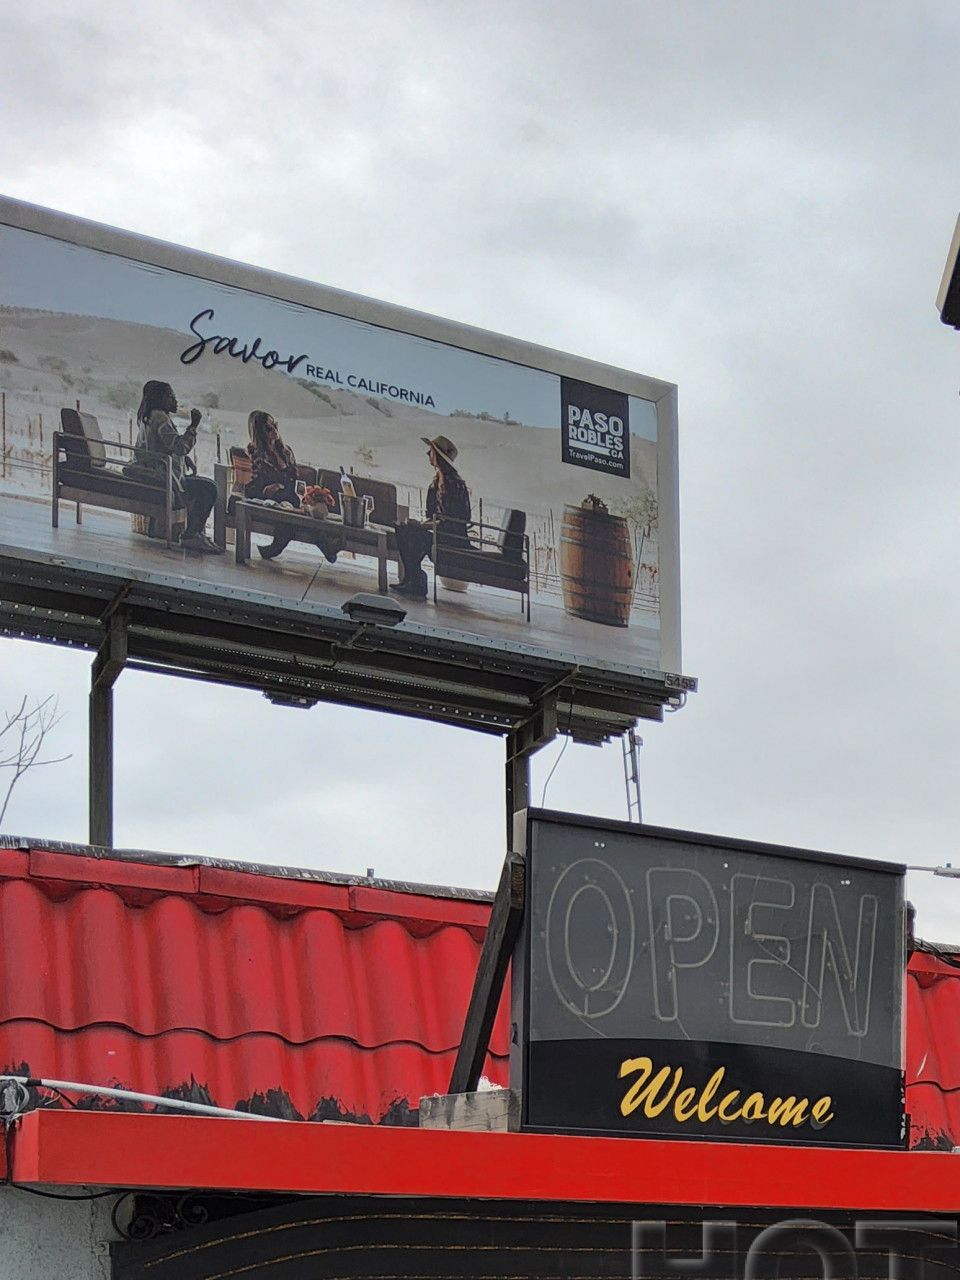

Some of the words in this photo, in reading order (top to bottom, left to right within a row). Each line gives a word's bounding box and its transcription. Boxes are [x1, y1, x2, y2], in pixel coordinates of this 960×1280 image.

[180, 309, 309, 373] Savor
[306, 364, 343, 384] REAL
[347, 375, 435, 408] CALIFORNIA
[568, 404, 624, 436] PASO
[568, 424, 624, 451] ROBLES
[569, 448, 624, 470] TravelPaso.com
[611, 450, 624, 460] CA
[545, 858, 880, 1037] OPEN
[619, 1056, 835, 1127] Welcome
